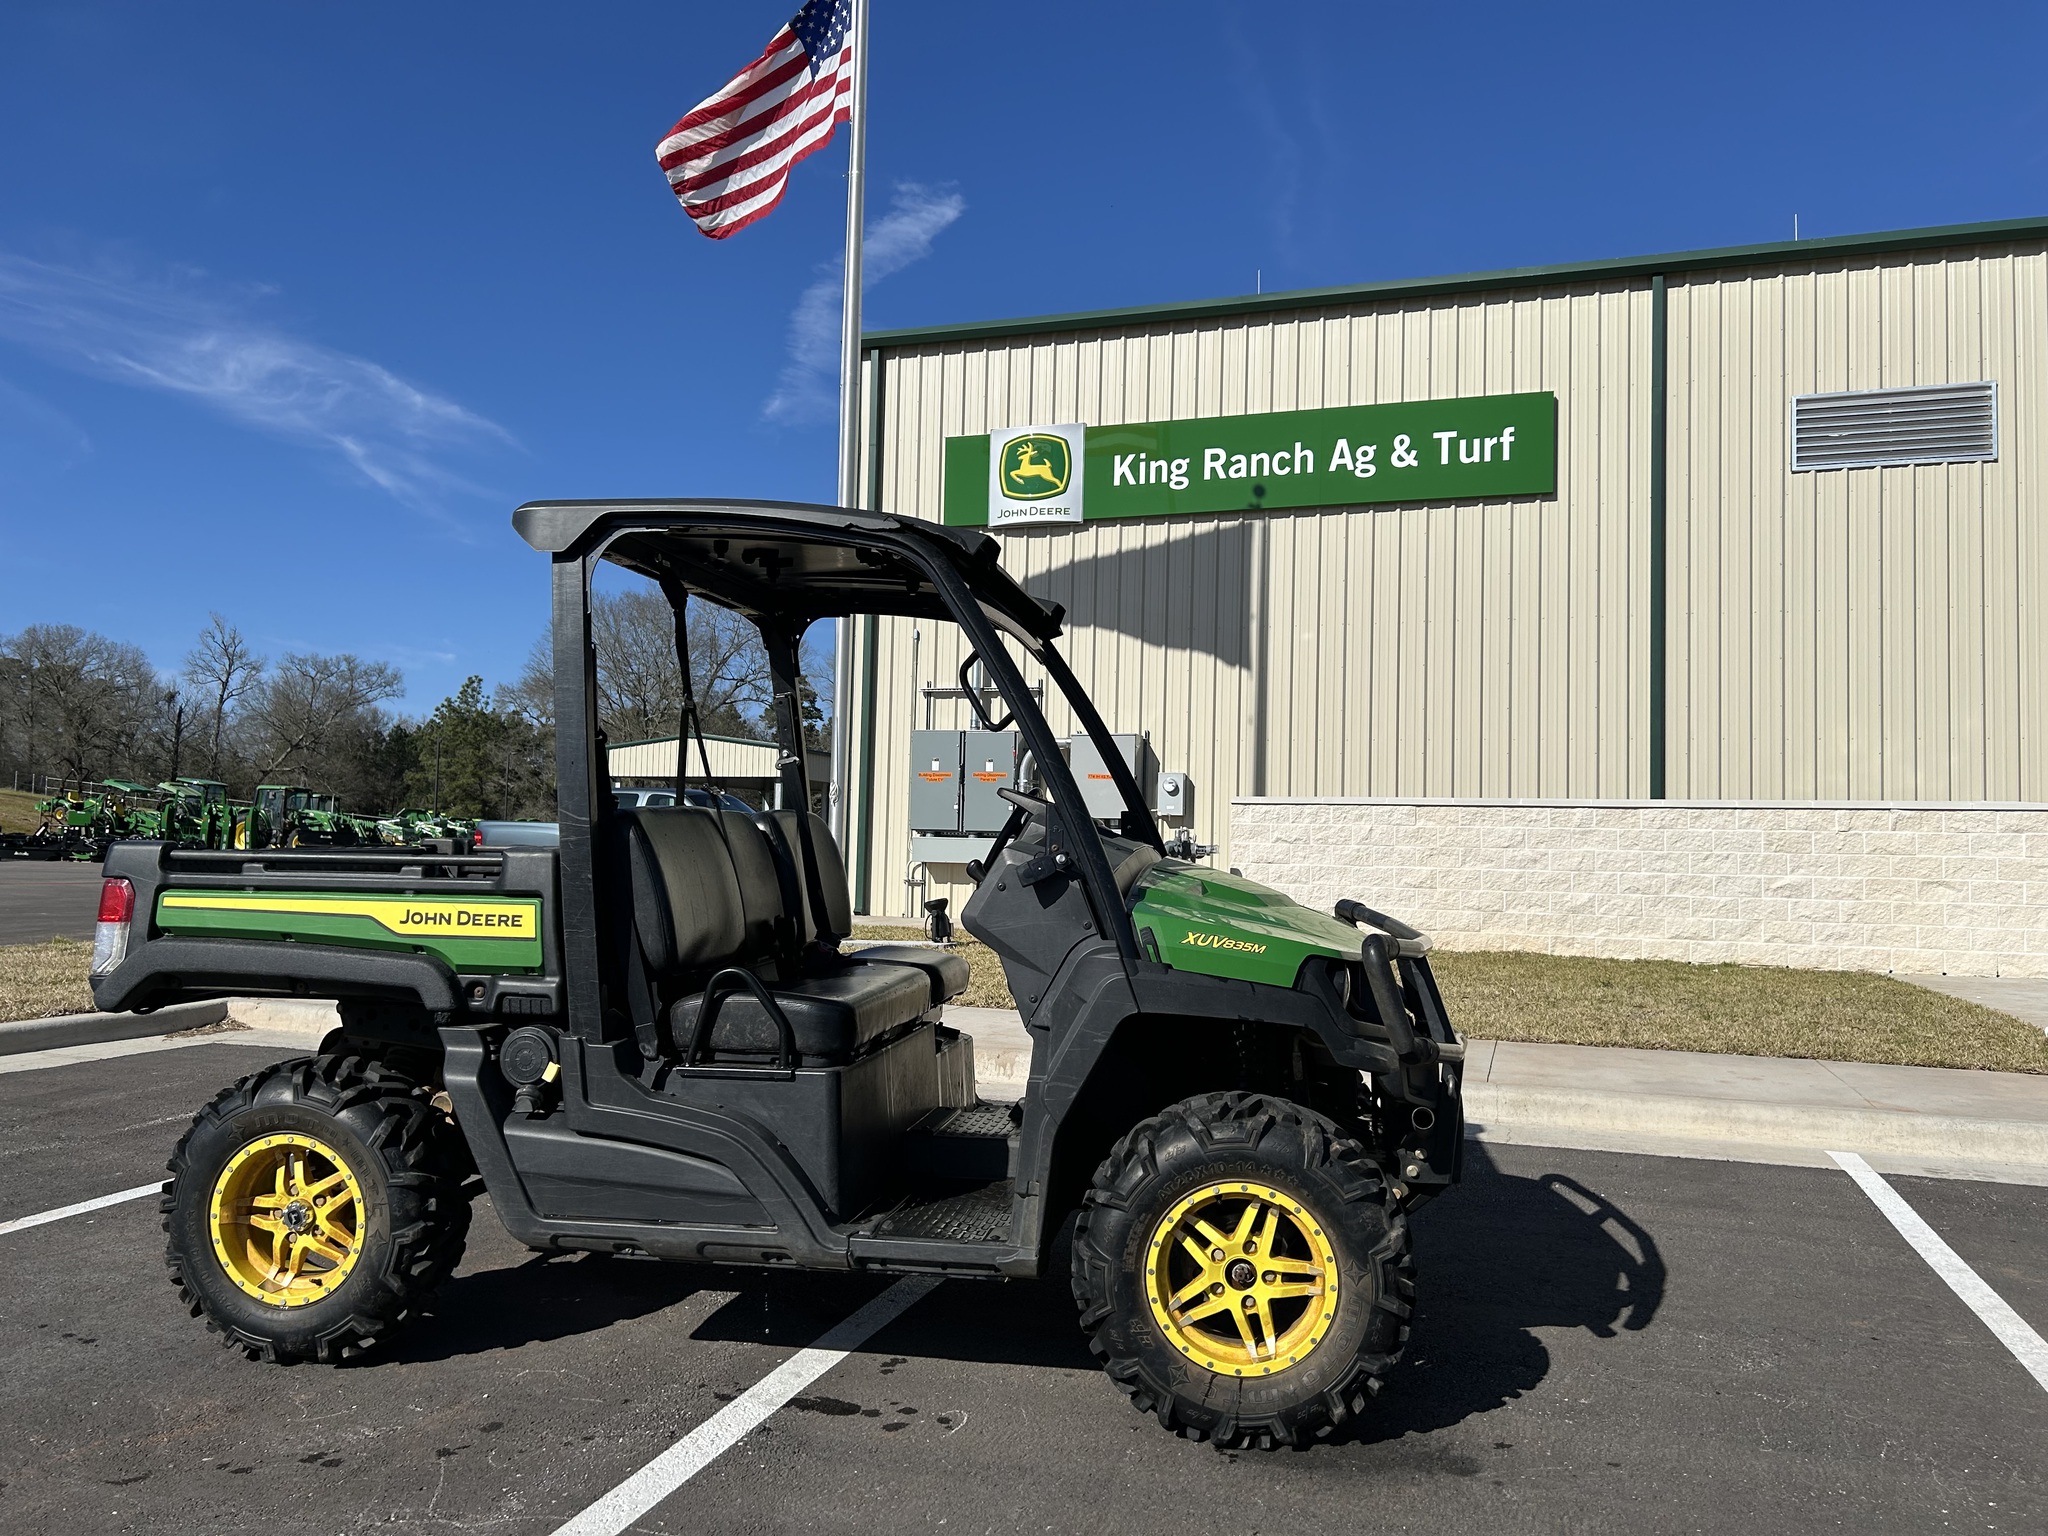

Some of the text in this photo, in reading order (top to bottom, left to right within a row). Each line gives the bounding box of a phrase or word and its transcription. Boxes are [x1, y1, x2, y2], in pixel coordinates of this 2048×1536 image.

[1113, 426, 1515, 490] King Ranch Ag & Turf
[997, 506, 1071, 519] JOHN DEERE
[399, 909, 523, 928] JOHN DEERE
[1181, 931, 1267, 954] XUV835M
